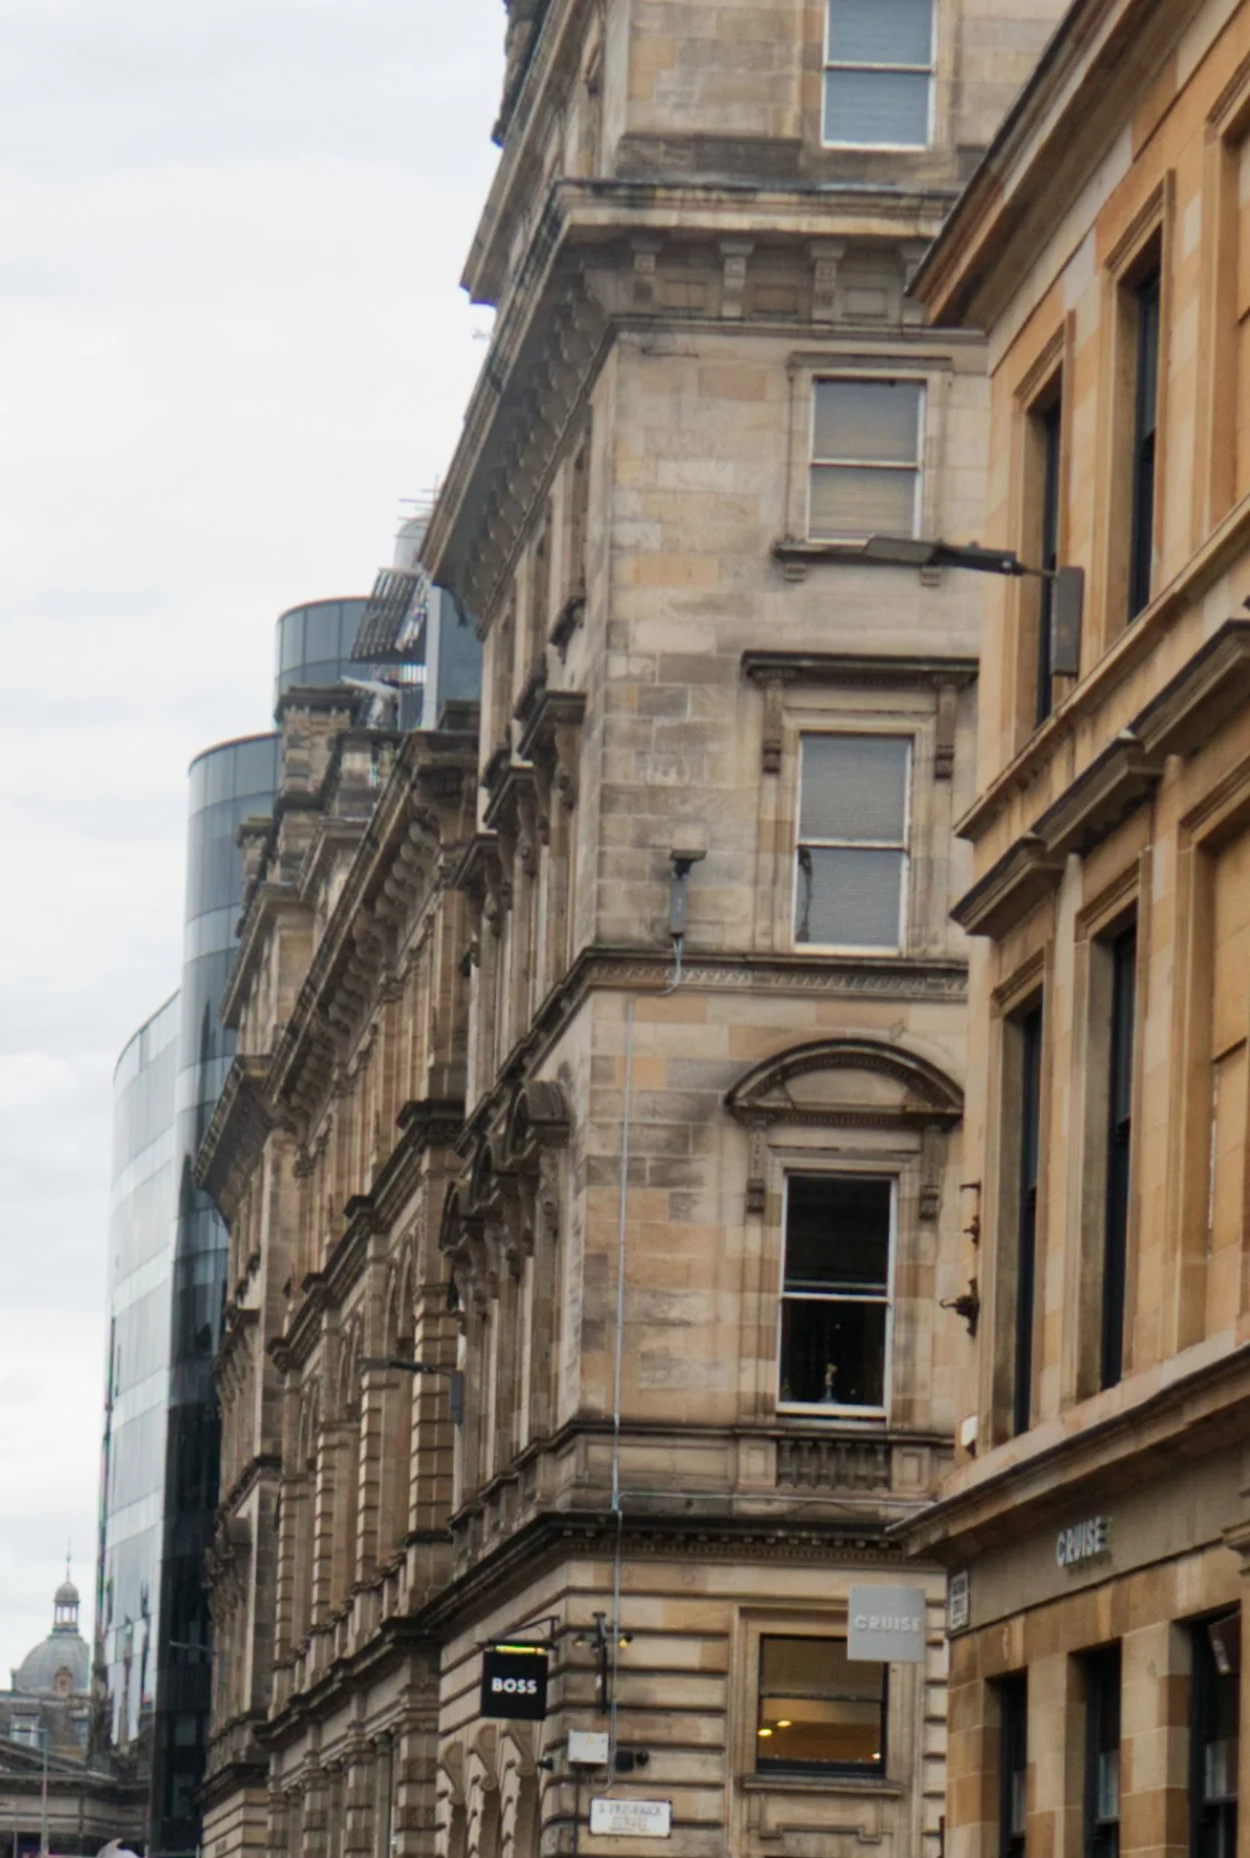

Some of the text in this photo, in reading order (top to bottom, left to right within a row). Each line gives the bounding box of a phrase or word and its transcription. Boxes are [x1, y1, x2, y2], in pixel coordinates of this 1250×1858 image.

[1056, 1516, 1109, 1567] CRUISE
[854, 1613, 921, 1632] CRUISE
[492, 1677, 538, 1695] BOSS
